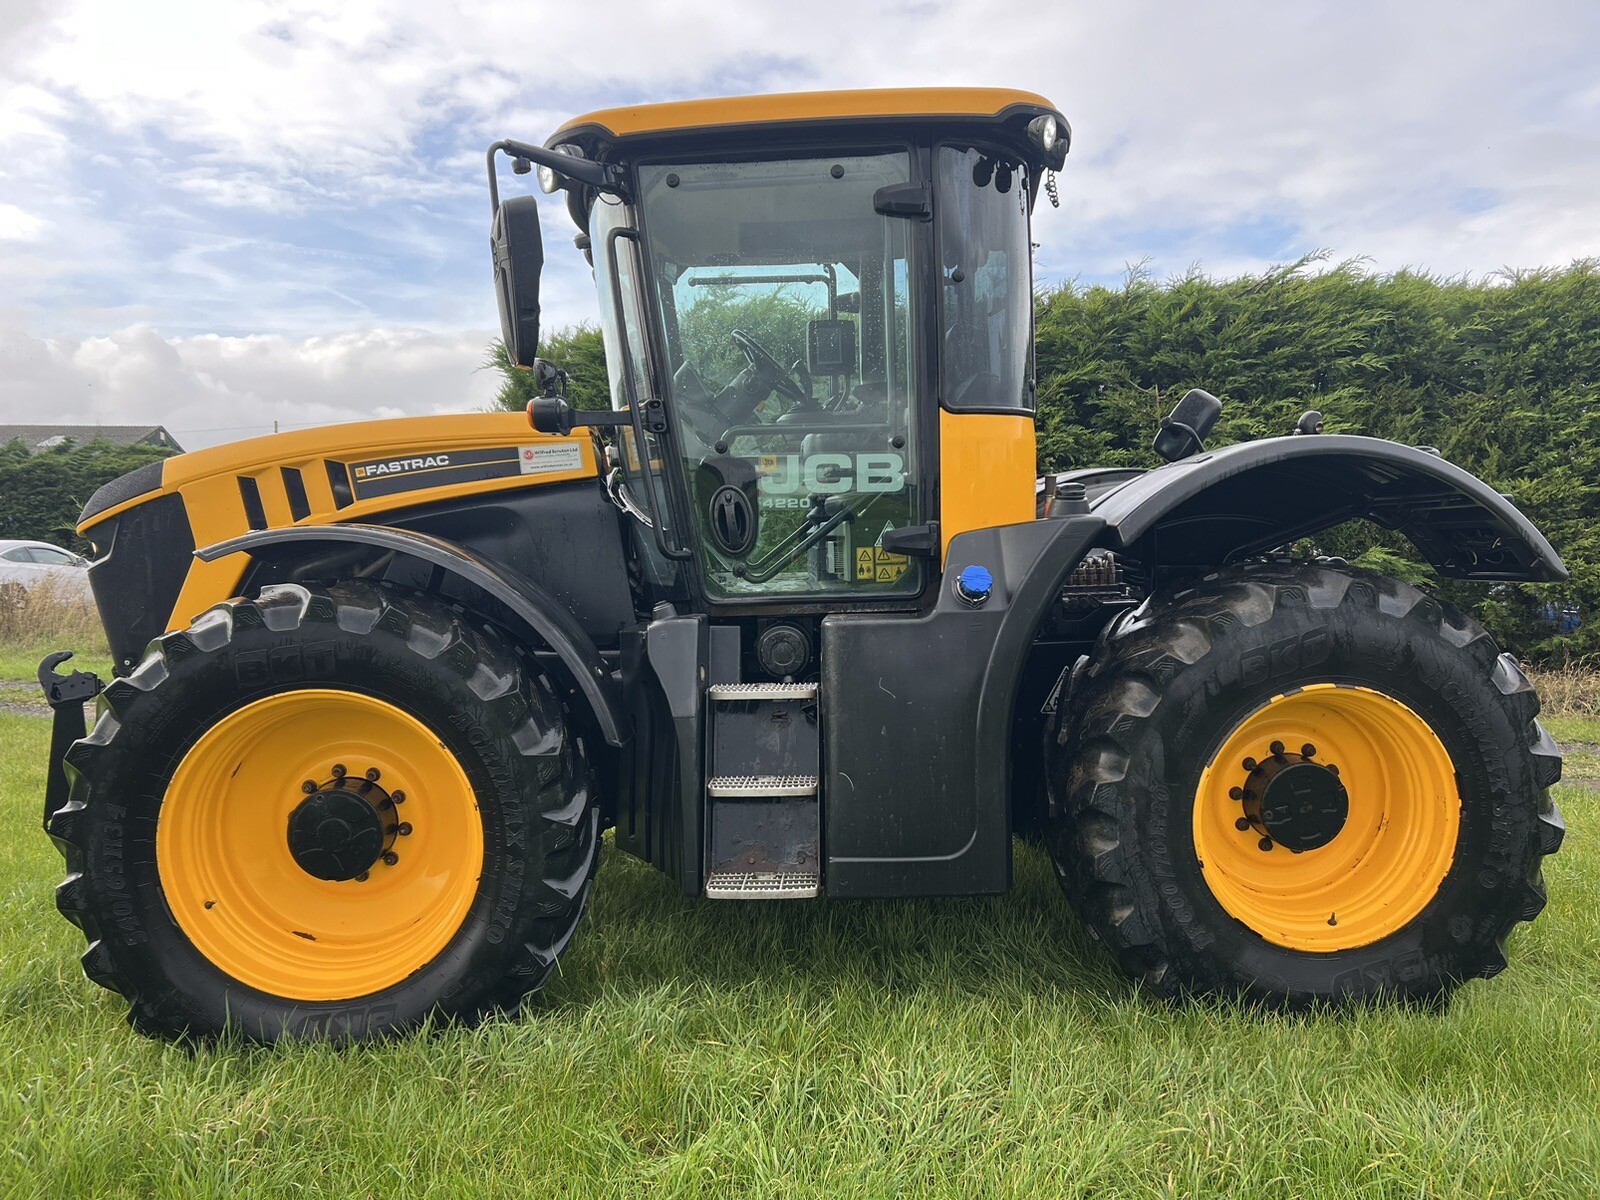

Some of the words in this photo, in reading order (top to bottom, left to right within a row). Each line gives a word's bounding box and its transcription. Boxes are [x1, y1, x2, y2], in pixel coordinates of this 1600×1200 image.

[365, 455, 449, 476] FASTRAC
[760, 453, 905, 494] JCB
[762, 498, 811, 508] 4220
[449, 710, 528, 850] AGRIMAX
[102, 802, 149, 947] 540/65R34
[485, 854, 526, 945] SIRIO
